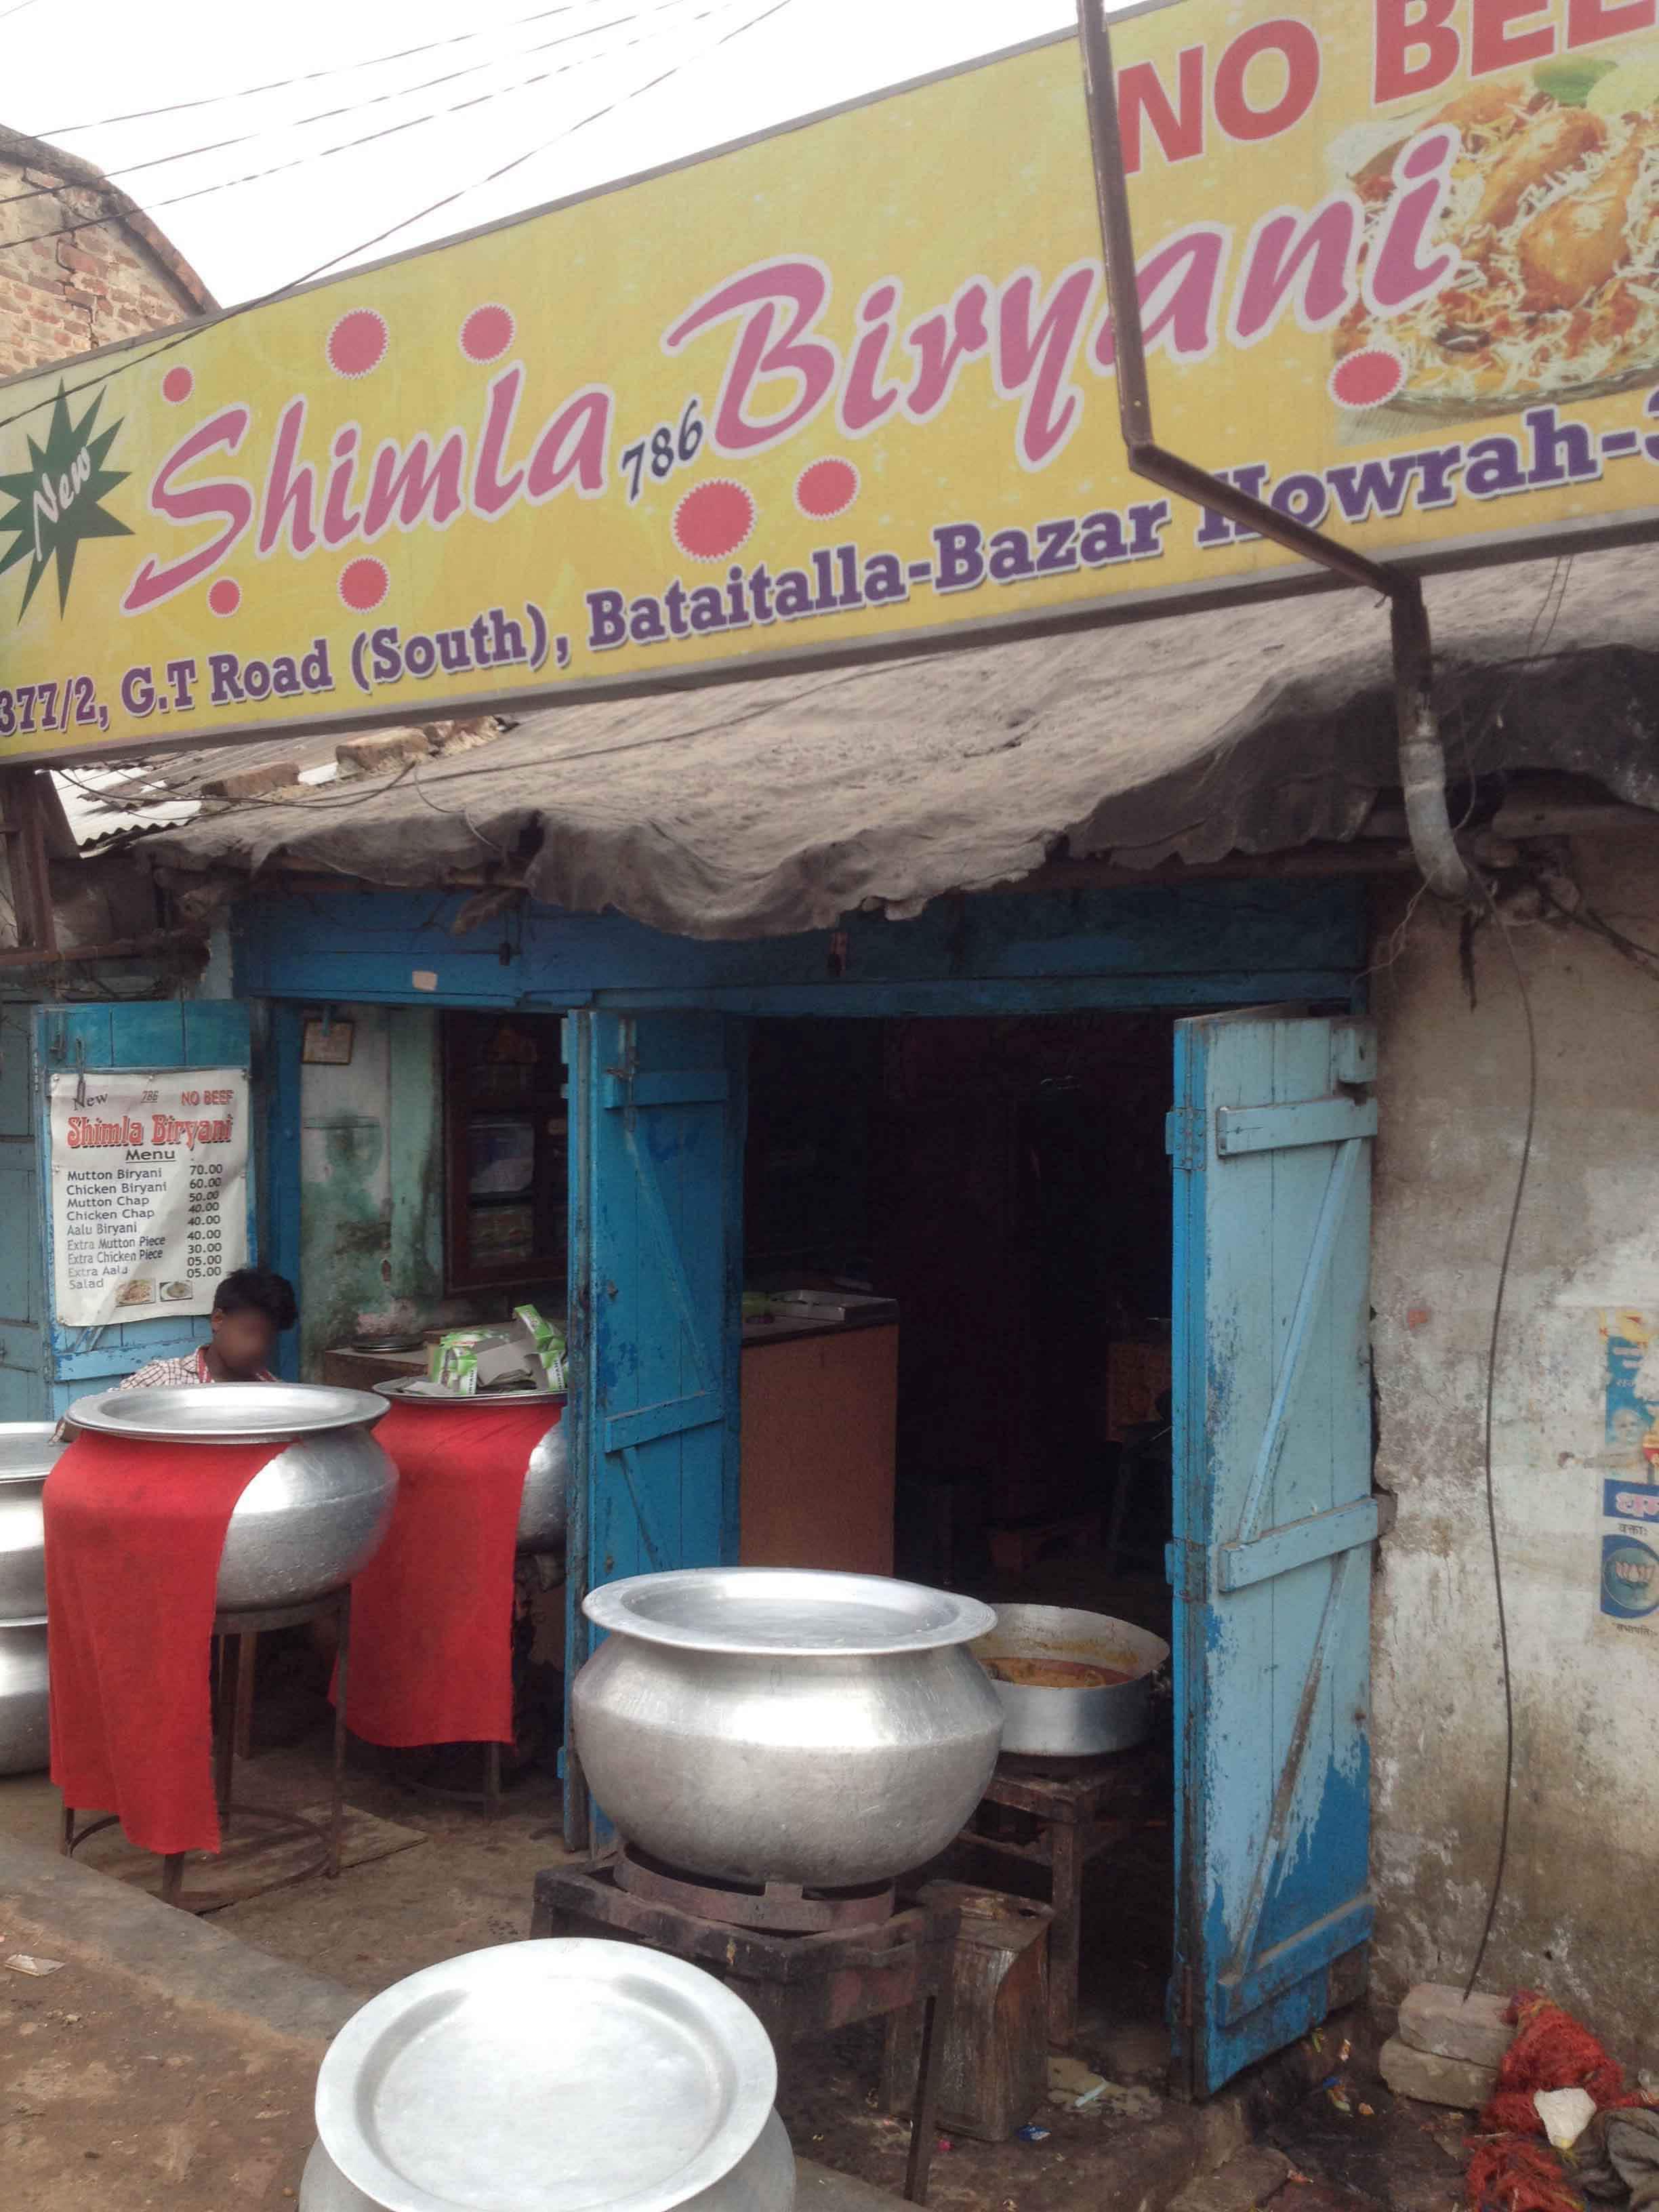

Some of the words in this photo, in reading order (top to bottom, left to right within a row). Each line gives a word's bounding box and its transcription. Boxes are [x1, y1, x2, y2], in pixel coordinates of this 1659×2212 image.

[1118, 19, 1320, 174] NO
[123, 365, 610, 613] Shimla
[667, 136, 1452, 462] Biryani
[621, 400, 704, 501] 786
[34, 445, 91, 562] New
[0, 676, 108, 733] 377/2,
[121, 660, 196, 716] G.T
[211, 640, 333, 703] Road
[351, 602, 569, 691] (South),
[588, 501, 1168, 646] Bataitalla-Bazar
[1198, 390, 1659, 543] Howrah-
[74, 1092, 108, 1111] New
[181, 1091, 200, 1106] NO
[203, 1090, 233, 1105] BEEF
[67, 1115, 144, 1148] Shimla
[152, 1114, 232, 1149] Biryani
[125, 1149, 176, 1162] Menu
[67, 1170, 112, 1181] Mutton
[117, 1168, 162, 1182] Biryani
[190, 1165, 223, 1175] 70.00
[66, 1183, 117, 1195] Chicken
[122, 1182, 167, 1193] Biryani
[190, 1178, 222, 1189] 60.00
[67, 1196, 112, 1208] Mutton
[117, 1195, 149, 1207] Chap
[189, 1191, 219, 1202] 50.00
[66, 1210, 117, 1221] Chicken
[122, 1209, 155, 1220] Chap
[188, 1203, 220, 1213] 40.00
[67, 1225, 92, 1235] Aalu
[97, 1223, 137, 1236] Biryani
[188, 1216, 220, 1225] 40.00
[68, 1240, 94, 1250] Extra
[98, 1238, 135, 1249] Mutton
[140, 1235, 165, 1247] Piece
[188, 1229, 221, 1240] 40.00
[68, 1252, 94, 1264] Extra
[97, 1251, 136, 1263] Chicken
[140, 1249, 163, 1260] Piece
[188, 1243, 222, 1253] 30.00
[68, 1267, 98, 1277] Extra
[188, 1256, 222, 1266] 05.00
[70, 1279, 104, 1288] Salad
[187, 1267, 221, 1277] 05.00
